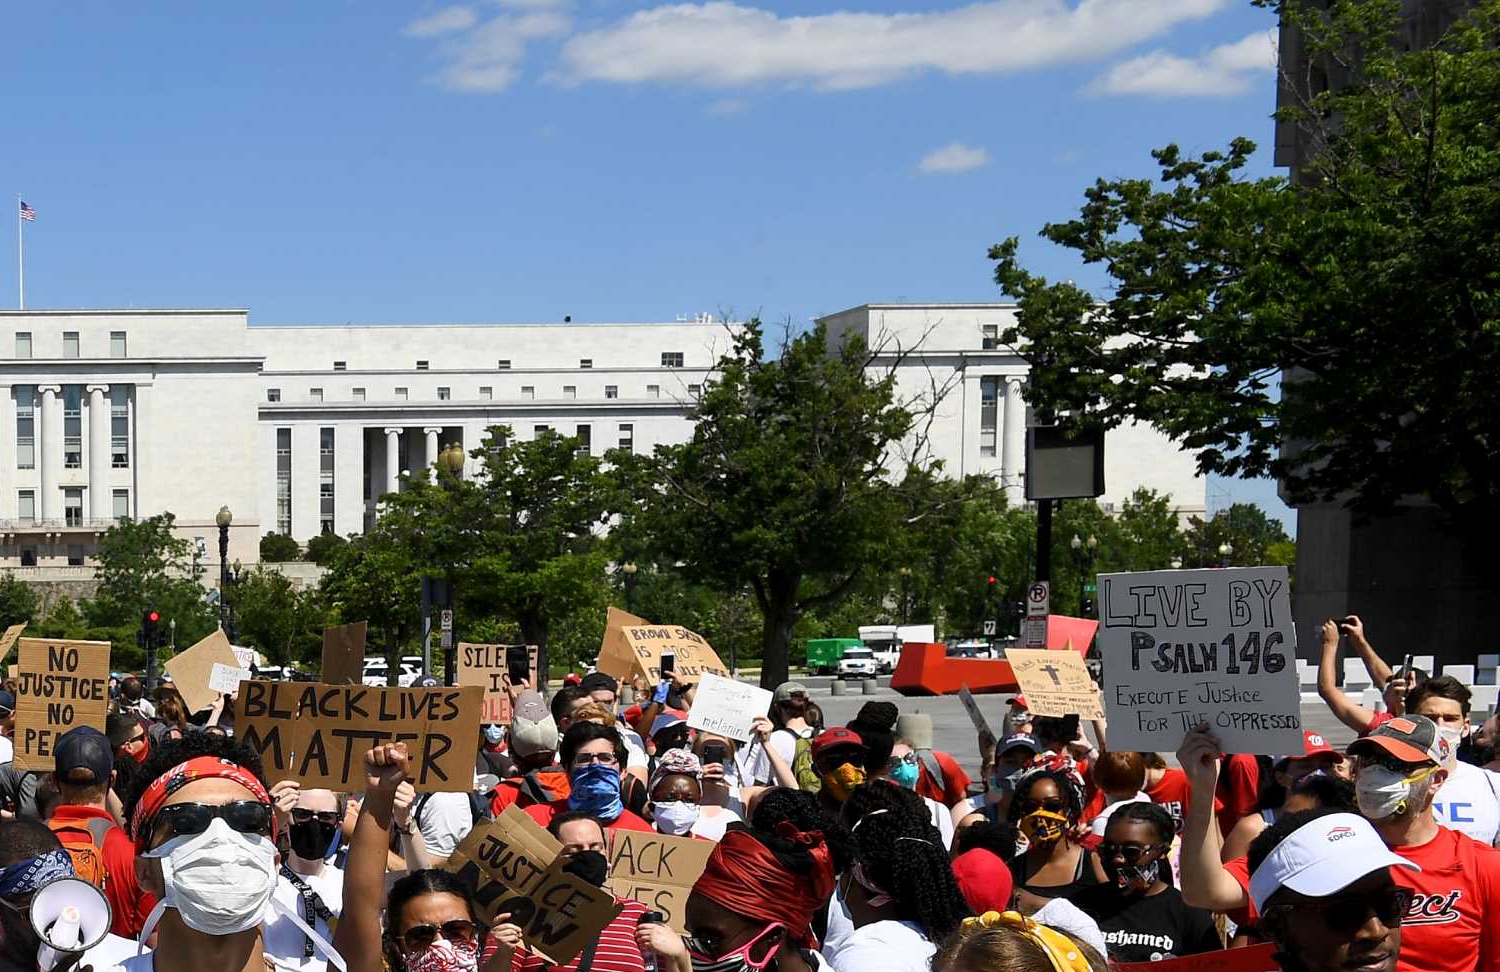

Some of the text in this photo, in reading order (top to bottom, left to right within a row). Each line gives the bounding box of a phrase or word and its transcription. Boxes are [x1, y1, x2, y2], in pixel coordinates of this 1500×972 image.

[1104, 579, 1282, 628] LIVE BY
[48, 646, 79, 672] NO
[464, 647, 536, 670] SILEE
[1221, 631, 1287, 675] 146
[19, 672, 105, 700] JUSTICE
[489, 672, 510, 693] IS
[47, 703, 74, 725] NO
[244, 681, 460, 721] BLACK LIVES
[1137, 711, 1169, 732] FOR
[1216, 711, 1300, 731] OPPRESSED
[478, 834, 598, 919] JUSTICE
